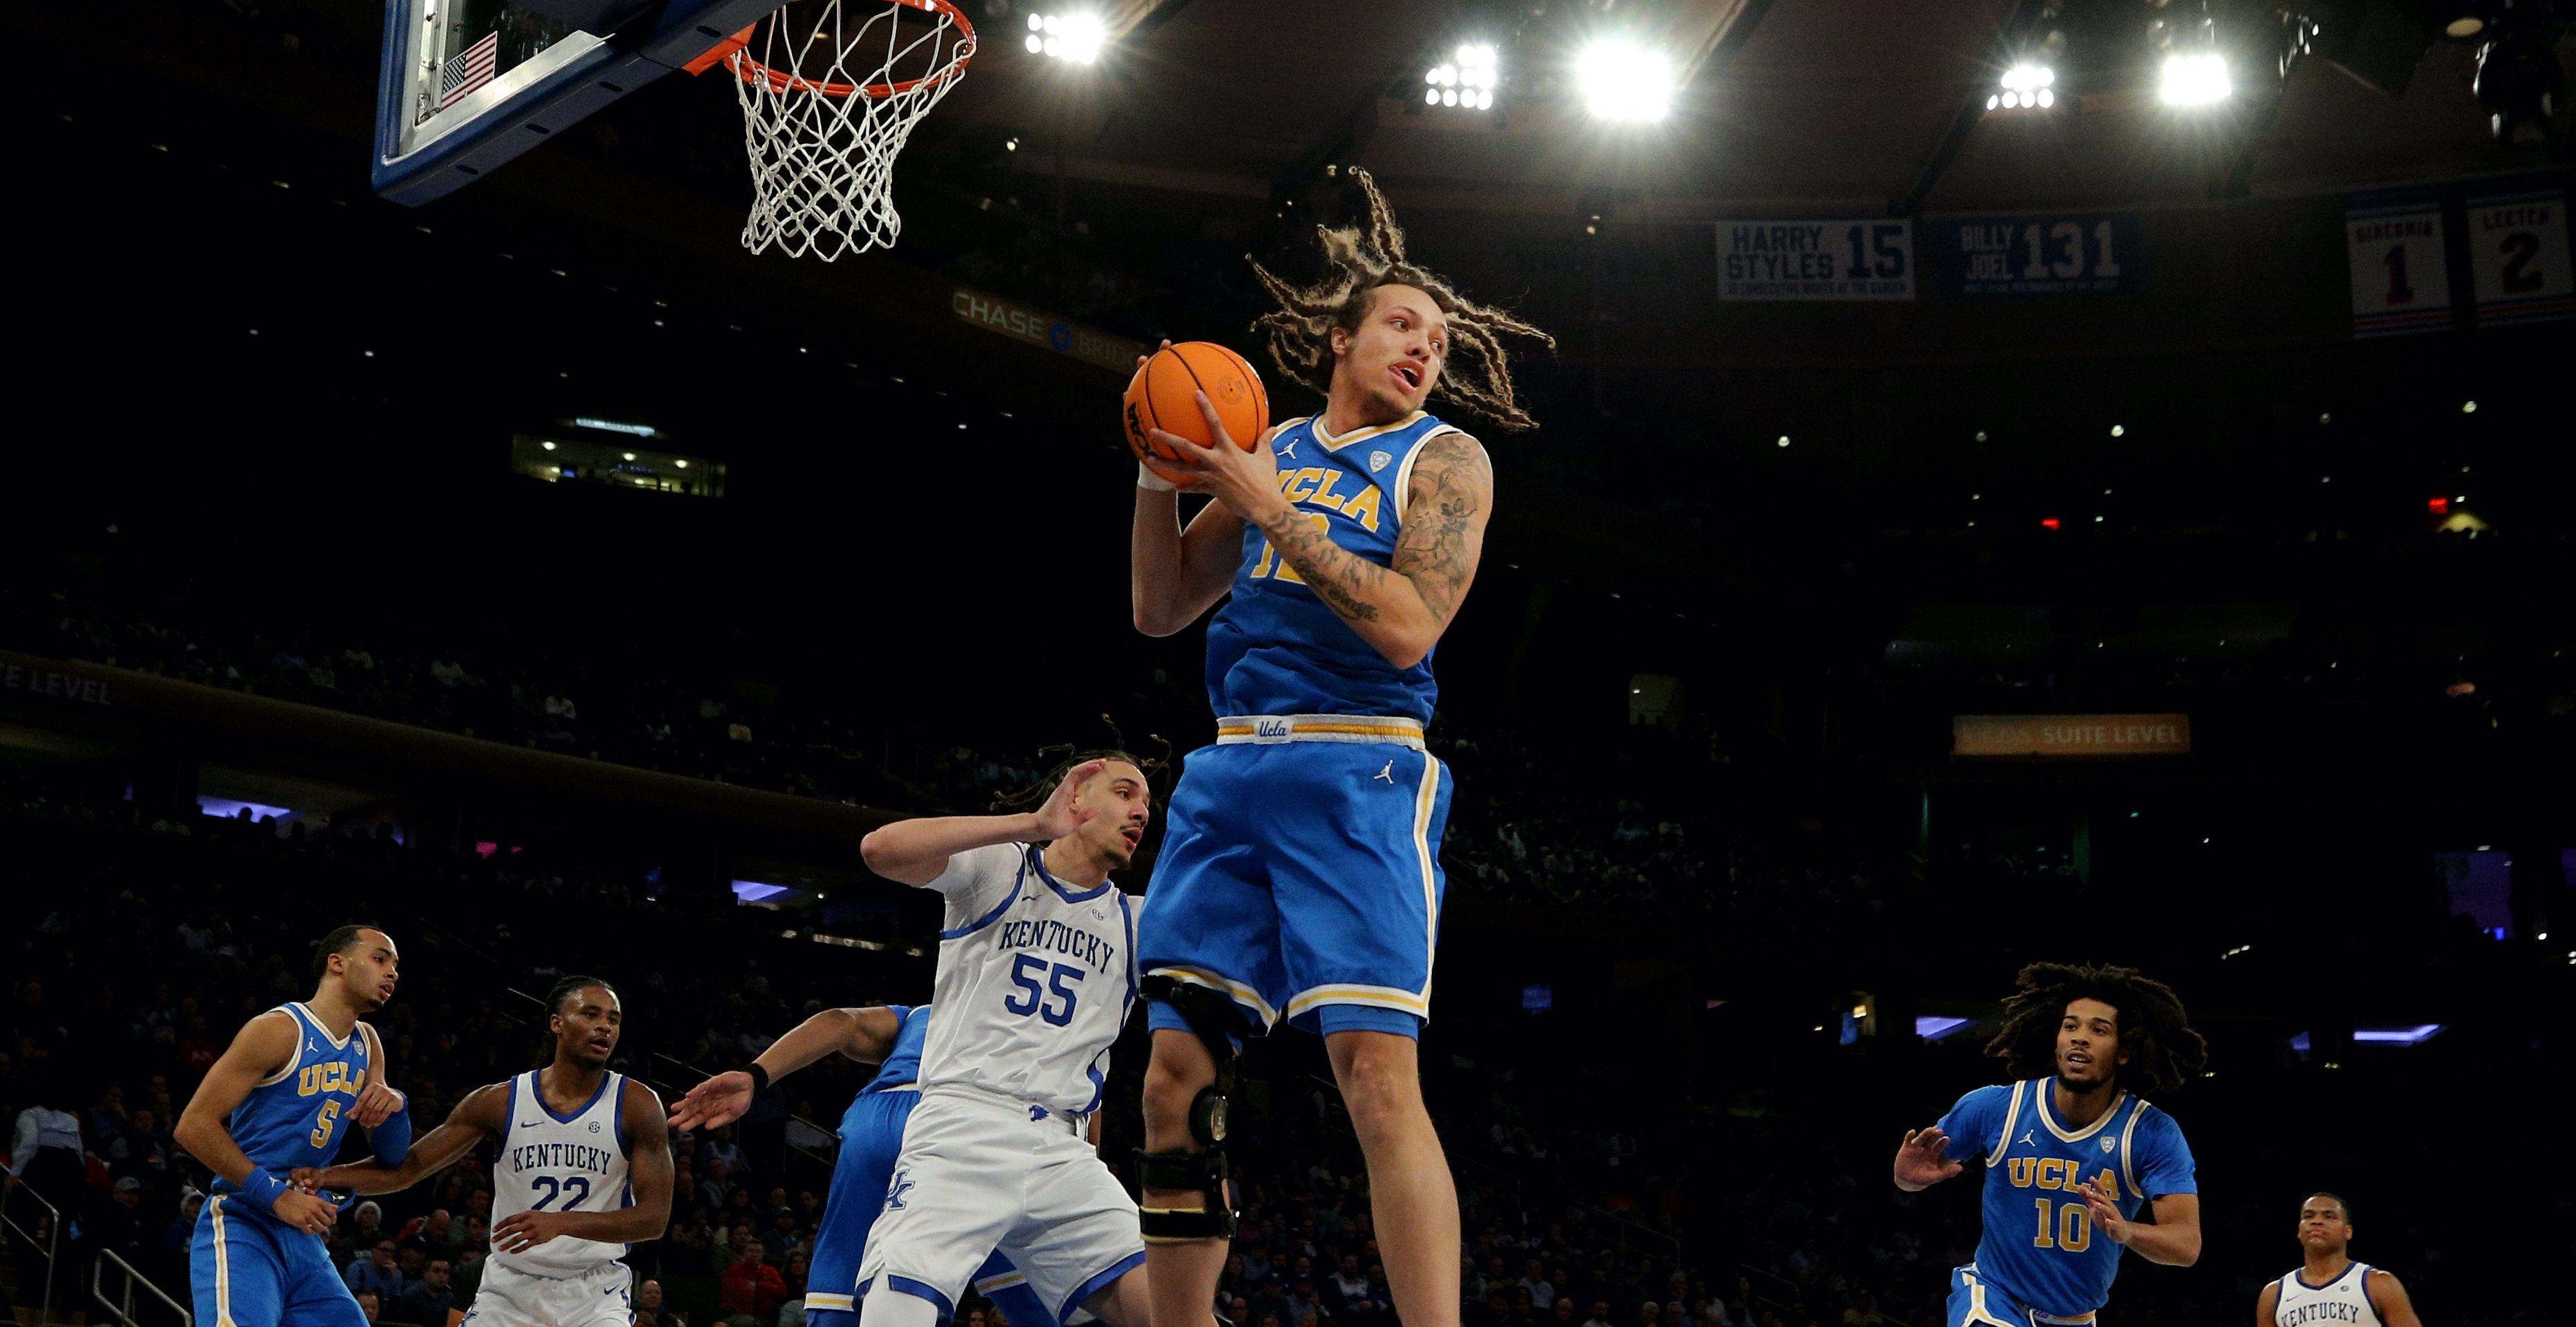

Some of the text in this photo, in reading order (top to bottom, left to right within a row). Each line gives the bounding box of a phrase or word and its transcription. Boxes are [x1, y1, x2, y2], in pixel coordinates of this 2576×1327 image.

[1732, 226, 1823, 252] HARRY
[1848, 225, 1906, 280] 15
[1962, 224, 2014, 251] BILLY
[2024, 220, 2120, 280] 131
[1727, 253, 1834, 280] STYLES
[1966, 253, 2015, 280] JOEL
[2385, 244, 2414, 305] 1
[2500, 233, 2544, 293] 2
[951, 290, 1045, 341] CHASE
[29, 668, 113, 707] LEVEL
[1259, 721, 1287, 737] Ucla
[2042, 724, 2107, 744] SUITE
[2113, 724, 2182, 744] LEVEL
[999, 920, 1114, 974] KENTUCKY
[1005, 953, 1085, 1027] 55
[297, 1061, 365, 1097] UCLA
[311, 1098, 341, 1149] 5
[514, 1143, 611, 1174] KENTUCKY
[531, 1176, 590, 1212] 22
[2008, 1156, 2120, 1201] UCLA
[2033, 1197, 2091, 1252] 10
[2281, 1302, 2359, 1327] KENTUCKY
